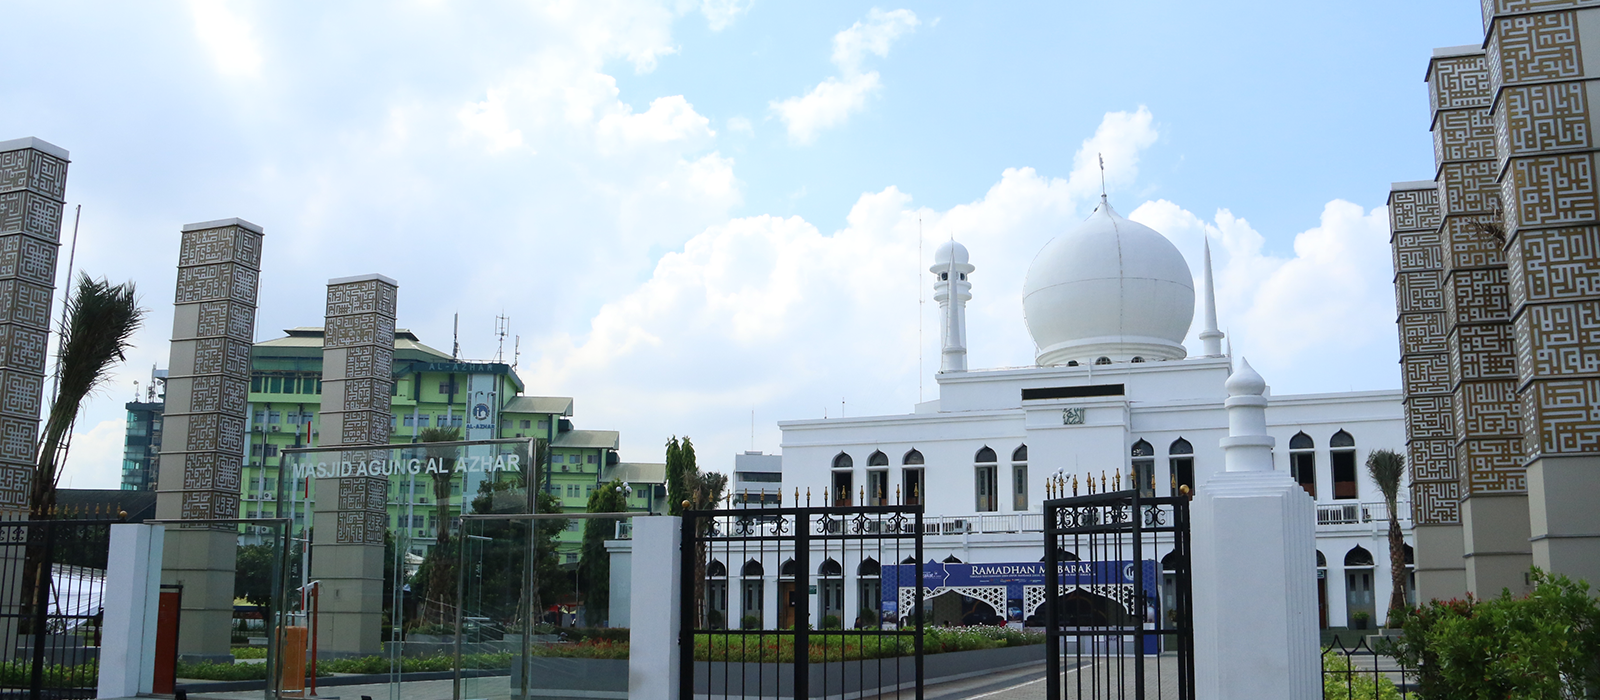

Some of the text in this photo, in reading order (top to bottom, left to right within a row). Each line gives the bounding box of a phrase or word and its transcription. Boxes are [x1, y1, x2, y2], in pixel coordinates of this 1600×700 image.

[428, 363, 493, 371] AL-AZHAR
[293, 454, 522, 478] MASJID AGUNG AL AZHAR
[972, 563, 1092, 575] RAMADHAN MBARAK
